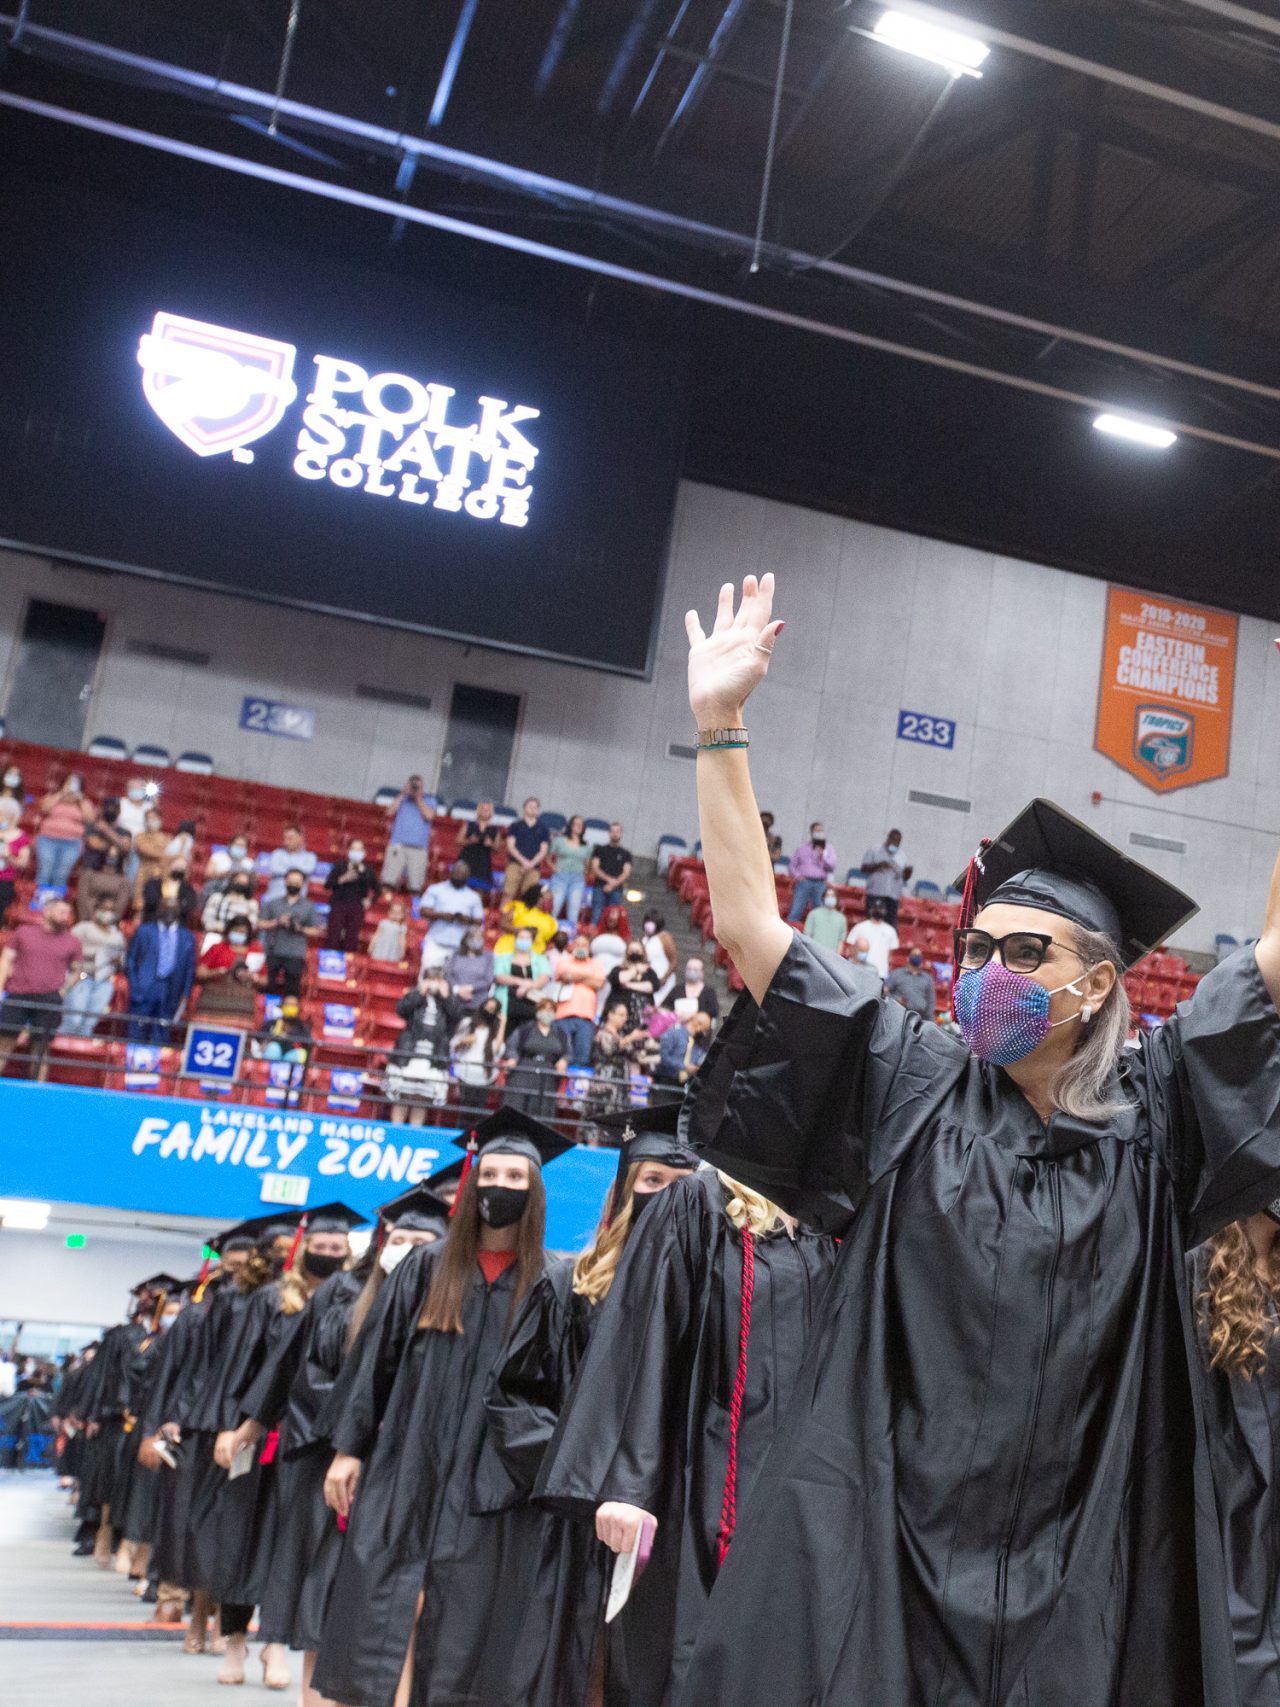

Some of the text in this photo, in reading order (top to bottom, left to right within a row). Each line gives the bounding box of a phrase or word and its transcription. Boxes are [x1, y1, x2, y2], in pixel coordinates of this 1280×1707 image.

[307, 354, 541, 457] POLK
[297, 403, 535, 502] STATE
[294, 450, 530, 528] COLLEGE
[1119, 645, 1219, 684] CONFERENCE
[1136, 631, 1205, 664] EASTERN
[1116, 664, 1219, 704] CHAMPIONS
[901, 715, 950, 745] 233
[1142, 713, 1186, 732] TROPICS
[194, 1040, 232, 1068] 32
[200, 1107, 387, 1142] LAKELAND MAGIC
[132, 1117, 440, 1184] FAMILY ZONE
